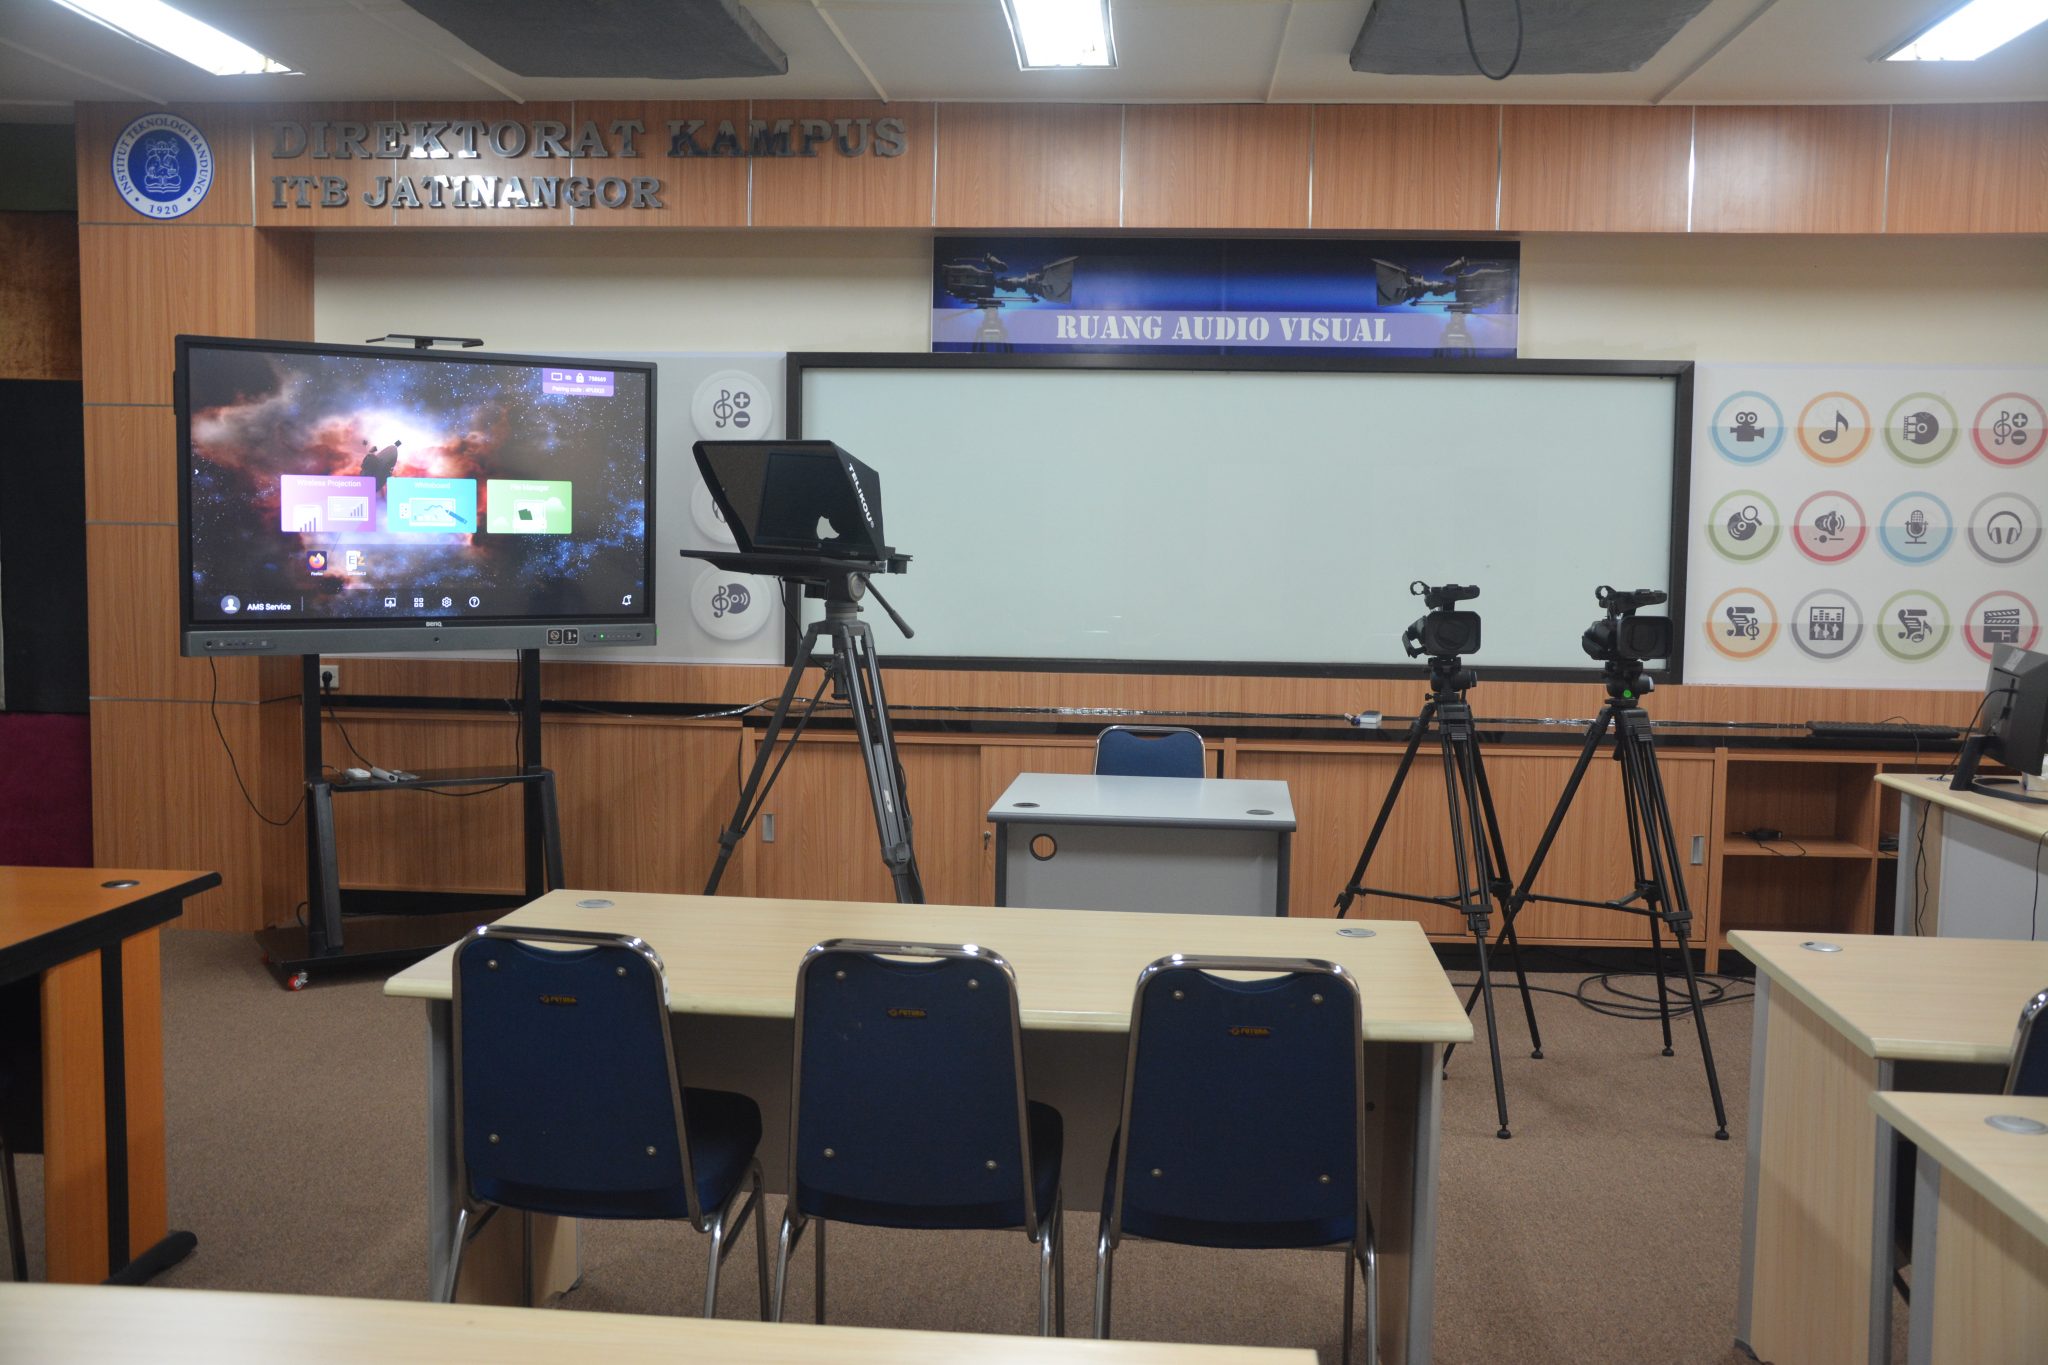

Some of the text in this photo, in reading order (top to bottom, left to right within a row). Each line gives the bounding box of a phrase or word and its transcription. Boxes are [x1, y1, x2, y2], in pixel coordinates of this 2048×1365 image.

[270, 117, 906, 159] DIREKTORAT KAMPUS
[116, 117, 209, 195] INSTITUT TEKNOLOGI BANDUNG
[271, 174, 663, 209] ITB JATINANGOR
[149, 204, 179, 215] 1920
[1056, 315, 1391, 342] RUANG AUDIO VISUAL
[327, 479, 361, 488] Projection
[849, 462, 872, 521] TELIKOU
[246, 602, 291, 611] AMS Service
